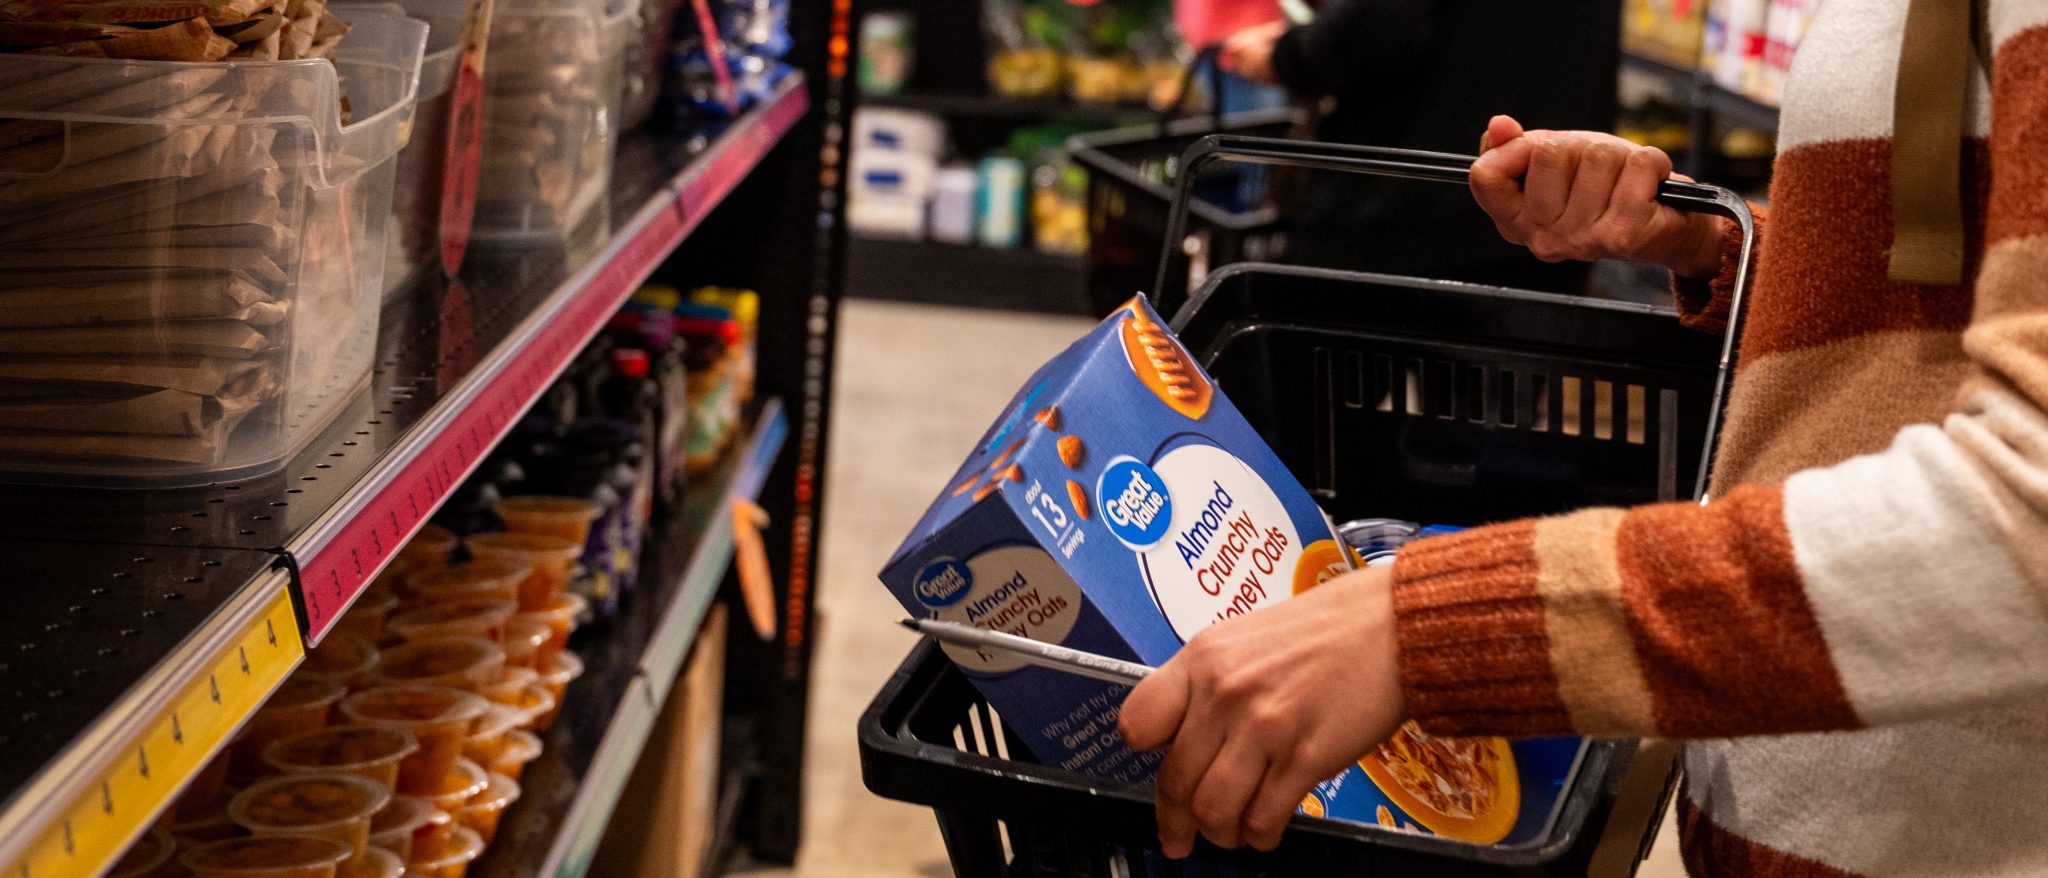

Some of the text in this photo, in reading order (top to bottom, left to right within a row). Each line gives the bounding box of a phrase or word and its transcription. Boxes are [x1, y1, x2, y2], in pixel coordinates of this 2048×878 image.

[1025, 478, 1043, 505] about
[1106, 468, 1153, 527] Great
[1131, 490, 1165, 532] Value
[1031, 492, 1067, 539] 13
[1175, 480, 1234, 571] Almond
[1197, 510, 1260, 597] Crunchy
[1211, 527, 1288, 624] oney Oats
[919, 564, 961, 598] Great
[936, 574, 967, 601] Value
[965, 569, 1029, 623] Almond
[1027, 595, 1068, 627] Oats
[239, 645, 250, 675] 4
[267, 618, 278, 648] 4
[1041, 717, 1071, 740] Why
[1068, 703, 1092, 725] not
[1089, 692, 1109, 713] try
[1063, 703, 1122, 749] Great Val
[1060, 740, 1102, 773] Instant
[1096, 748, 1133, 775] come
